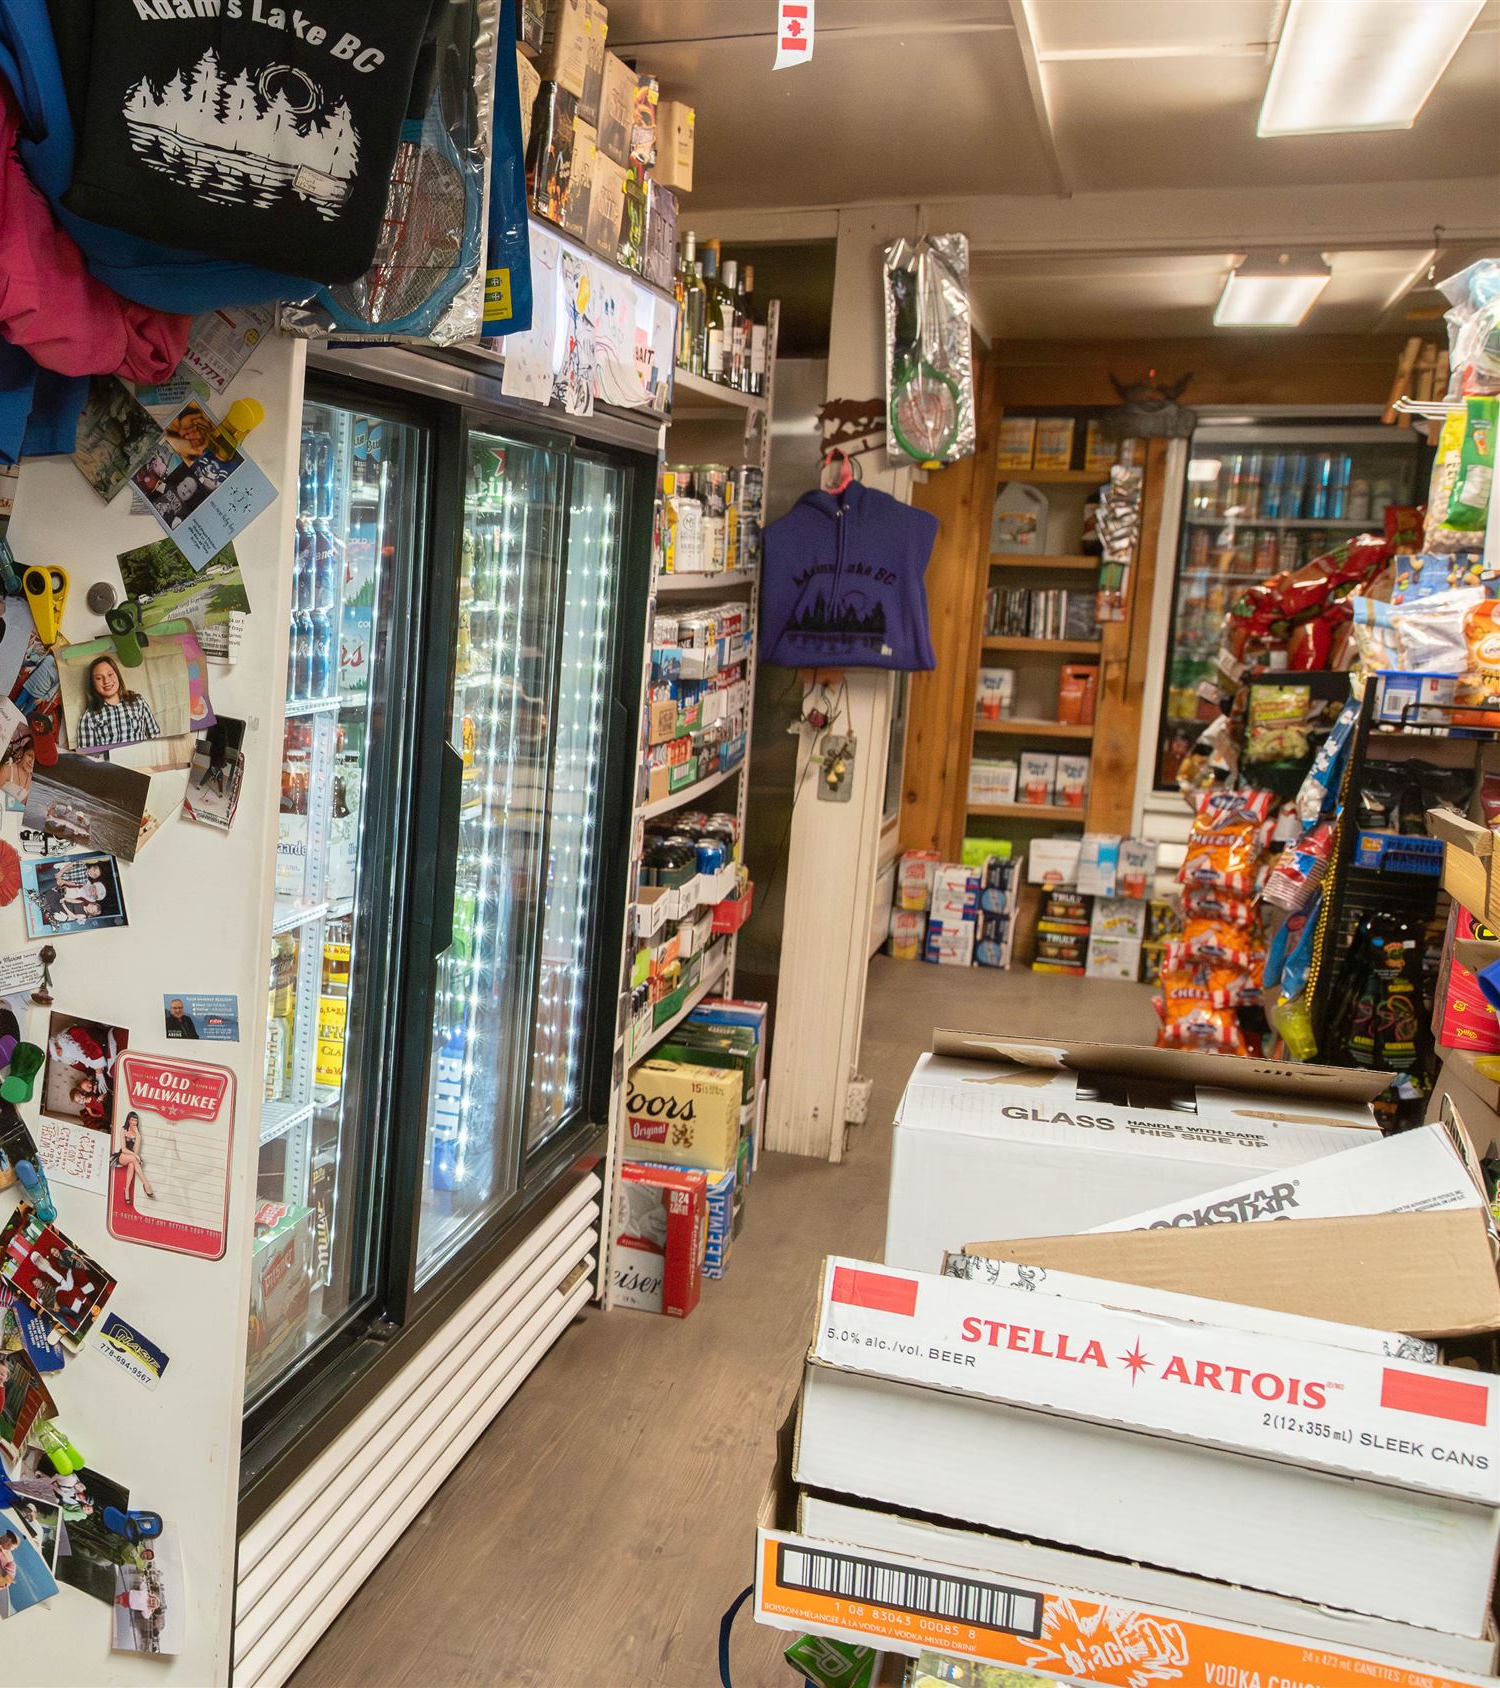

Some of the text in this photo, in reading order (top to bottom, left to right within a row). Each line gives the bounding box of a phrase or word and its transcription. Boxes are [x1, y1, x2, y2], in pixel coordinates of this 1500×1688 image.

[252, 0, 327, 46] Lake
[330, 32, 385, 73] BC
[635, 346, 655, 364] BAIT
[874, 567, 897, 586] BC
[1052, 893, 1083, 903] TRULY
[1046, 934, 1076, 944] TRULY
[132, 1080, 218, 1112] MILWAUKEE
[691, 1082, 701, 1094] 15
[632, 1121, 667, 1140] Original
[999, 1105, 1116, 1132] GLASS
[1127, 1119, 1265, 1141] HANDLE WITH CARE
[1128, 1127, 1269, 1149] THIS SIDE UP
[678, 1191, 690, 1205] 24
[1134, 1181, 1298, 1231] OCKSTAR
[702, 1184, 726, 1280] SLEEMAN
[826, 1326, 861, 1346] 5.0%
[928, 1347, 977, 1368] BEER
[100, 1342, 153, 1385] 778-694-9567
[960, 1315, 1327, 1410] STELLA ARTOIS
[1359, 1432, 1424, 1458] SLEEK
[1430, 1446, 1490, 1471] CANS
[764, 1601, 977, 1653] BOISSON MÉLANGÉE À LA VODKA VODKA MIXED DRINK
[835, 1602, 976, 1640] 1 08 83043 00085 8
[1203, 1660, 1262, 1688] VODKA
[1301, 1649, 1315, 1663] 24
[1320, 1655, 1340, 1670] 473
[1352, 1661, 1401, 1684] CANETTES
[1407, 1671, 1435, 1687] CANS
